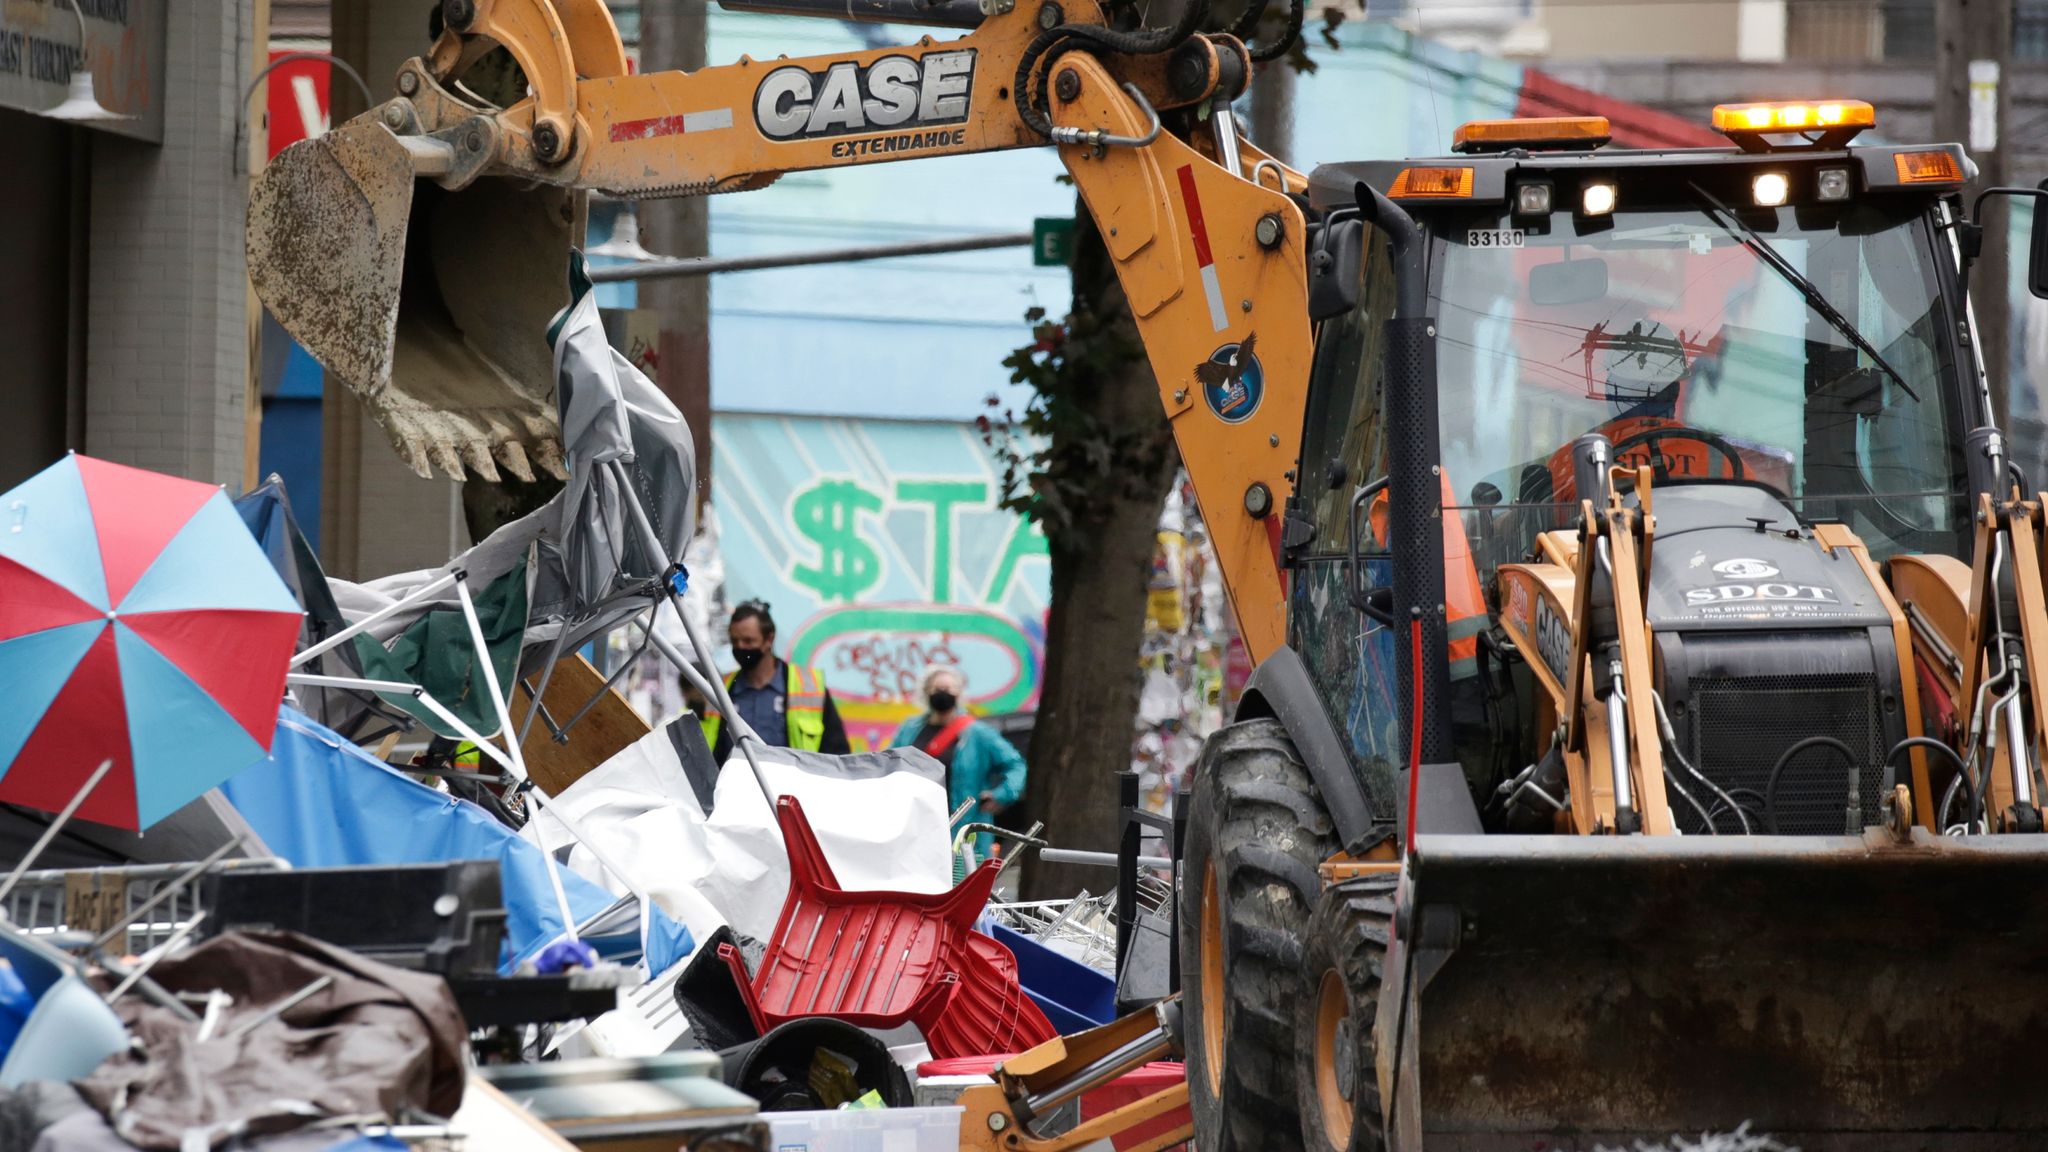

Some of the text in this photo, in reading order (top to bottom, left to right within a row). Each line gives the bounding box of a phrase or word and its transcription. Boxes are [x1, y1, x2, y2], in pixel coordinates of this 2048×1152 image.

[756, 51, 974, 138] CASE
[831, 129, 966, 159] EXTENDAHOE
[1469, 231, 1523, 246] 33130
[1685, 583, 1834, 602] SDOT
[1701, 606, 1721, 614] FOR
[1724, 605, 1767, 613] OFFICIAL
[1771, 604, 1789, 612] USE
